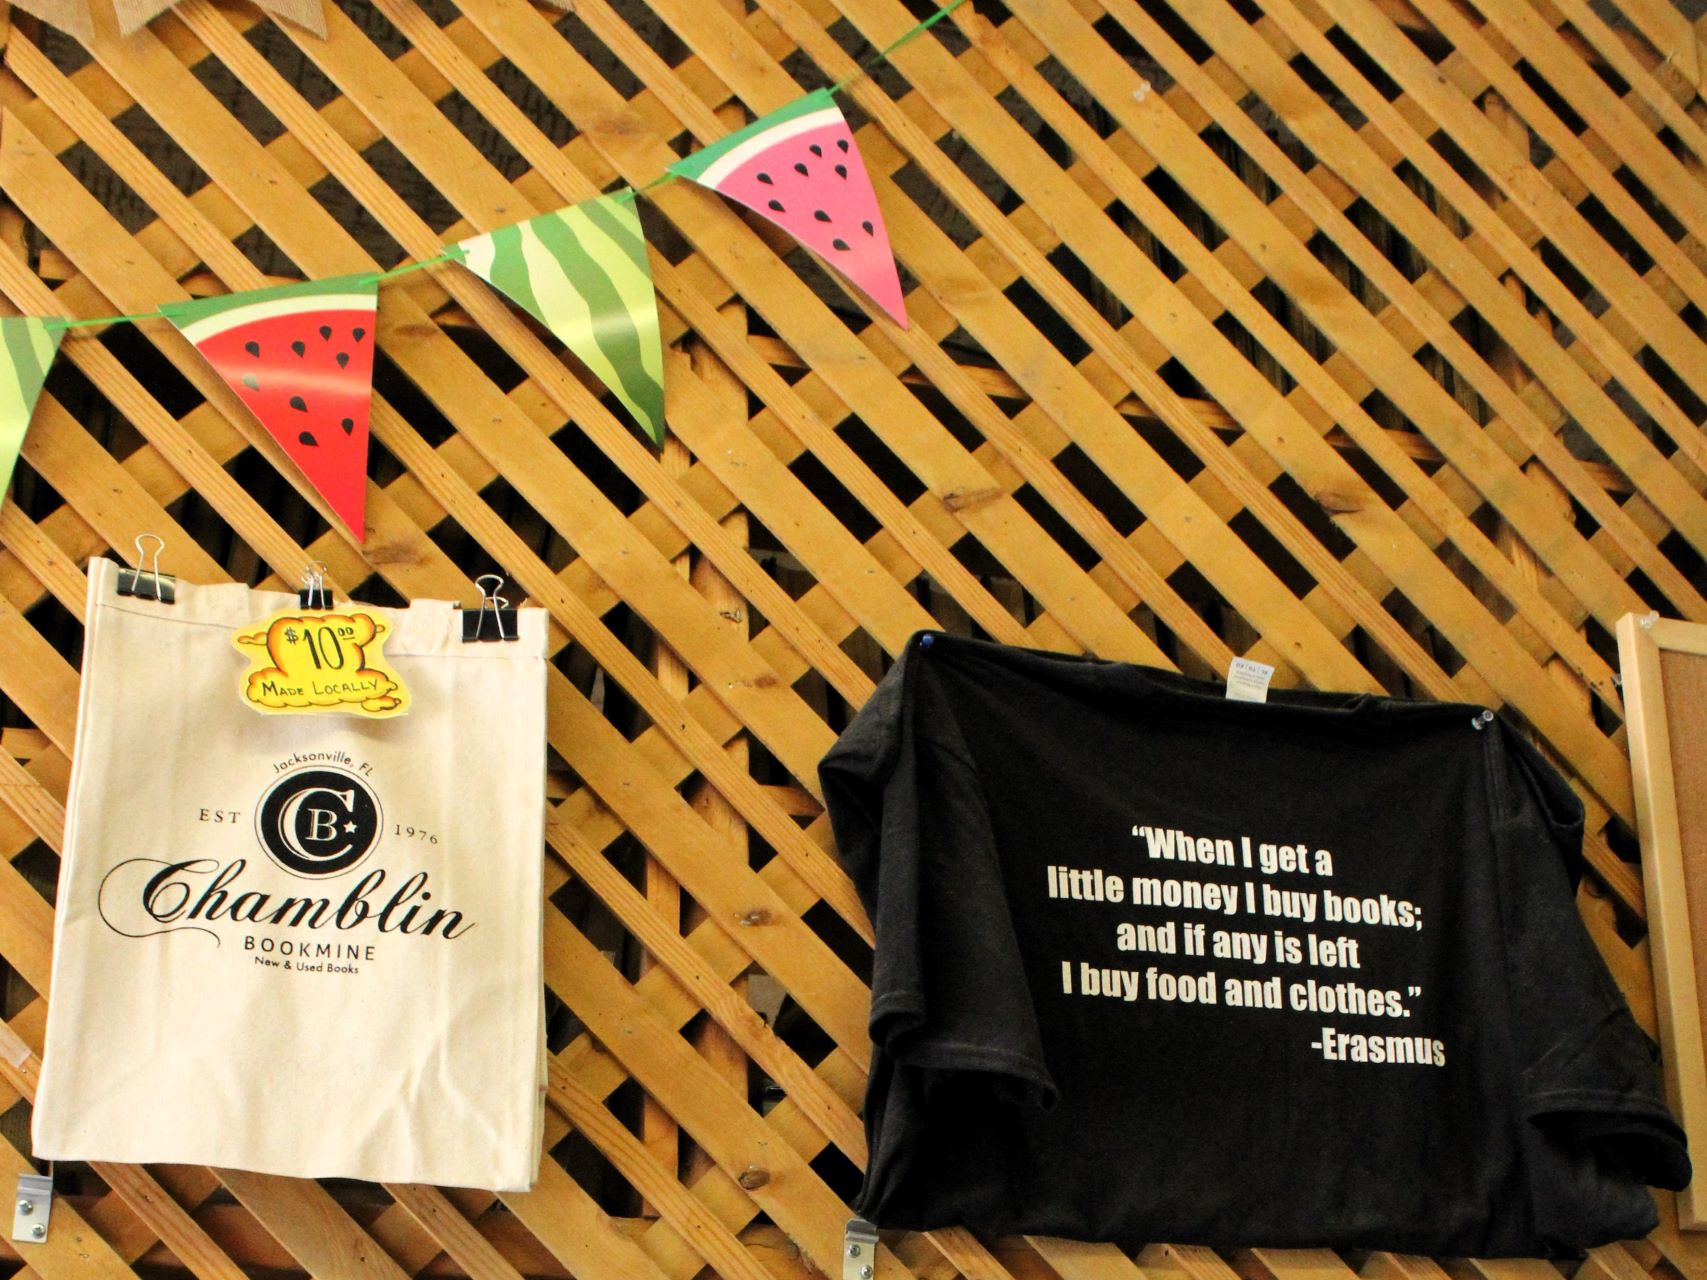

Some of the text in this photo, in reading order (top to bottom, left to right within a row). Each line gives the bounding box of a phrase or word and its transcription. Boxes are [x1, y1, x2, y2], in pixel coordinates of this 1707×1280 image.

[312, 679, 378, 695] LOCALLY
[272, 751, 374, 777] Jacksonville, FL
[199, 808, 242, 824] EST
[394, 824, 439, 845] 1976
[1241, 836, 1253, 868] I
[1259, 843, 1308, 875] get
[1315, 849, 1334, 877] a
[98, 858, 478, 948] Chamblin
[1047, 865, 1423, 932] little money I buy books;
[244, 936, 376, 961] BOOKMINE
[1117, 922, 1361, 969] and if any is left
[254, 956, 359, 975] New & Used Books
[1061, 961, 1073, 995] I
[1080, 962, 1139, 1003] buy
[1146, 967, 1217, 1005] food
[1224, 976, 1283, 1010] and
[1311, 1027, 1446, 1068] -Erasmus
